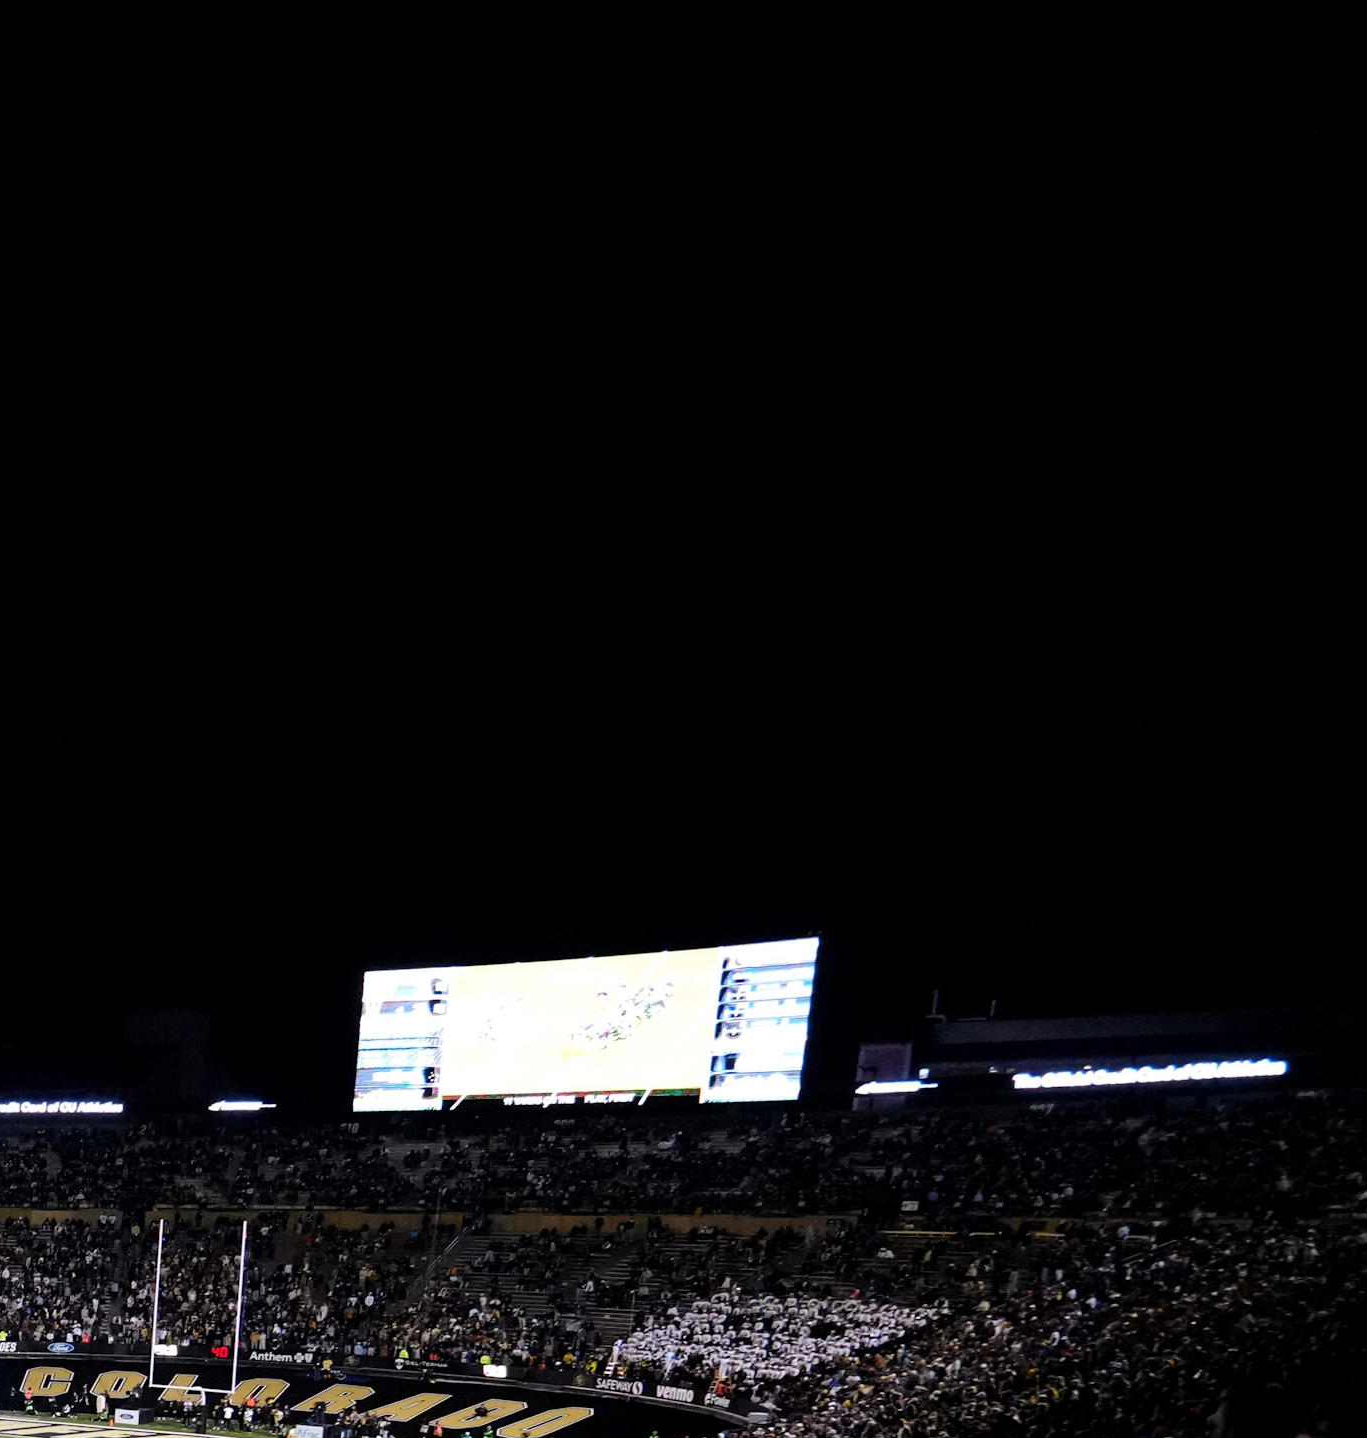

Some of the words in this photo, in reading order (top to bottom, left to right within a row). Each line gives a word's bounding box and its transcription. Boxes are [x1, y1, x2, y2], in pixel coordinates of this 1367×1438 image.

[249, 1350, 293, 1363] Anthem
[596, 1378, 632, 1392] SAFEWAY
[19, 1366, 594, 1438] COLORADO
[656, 1385, 694, 1403] venmo
